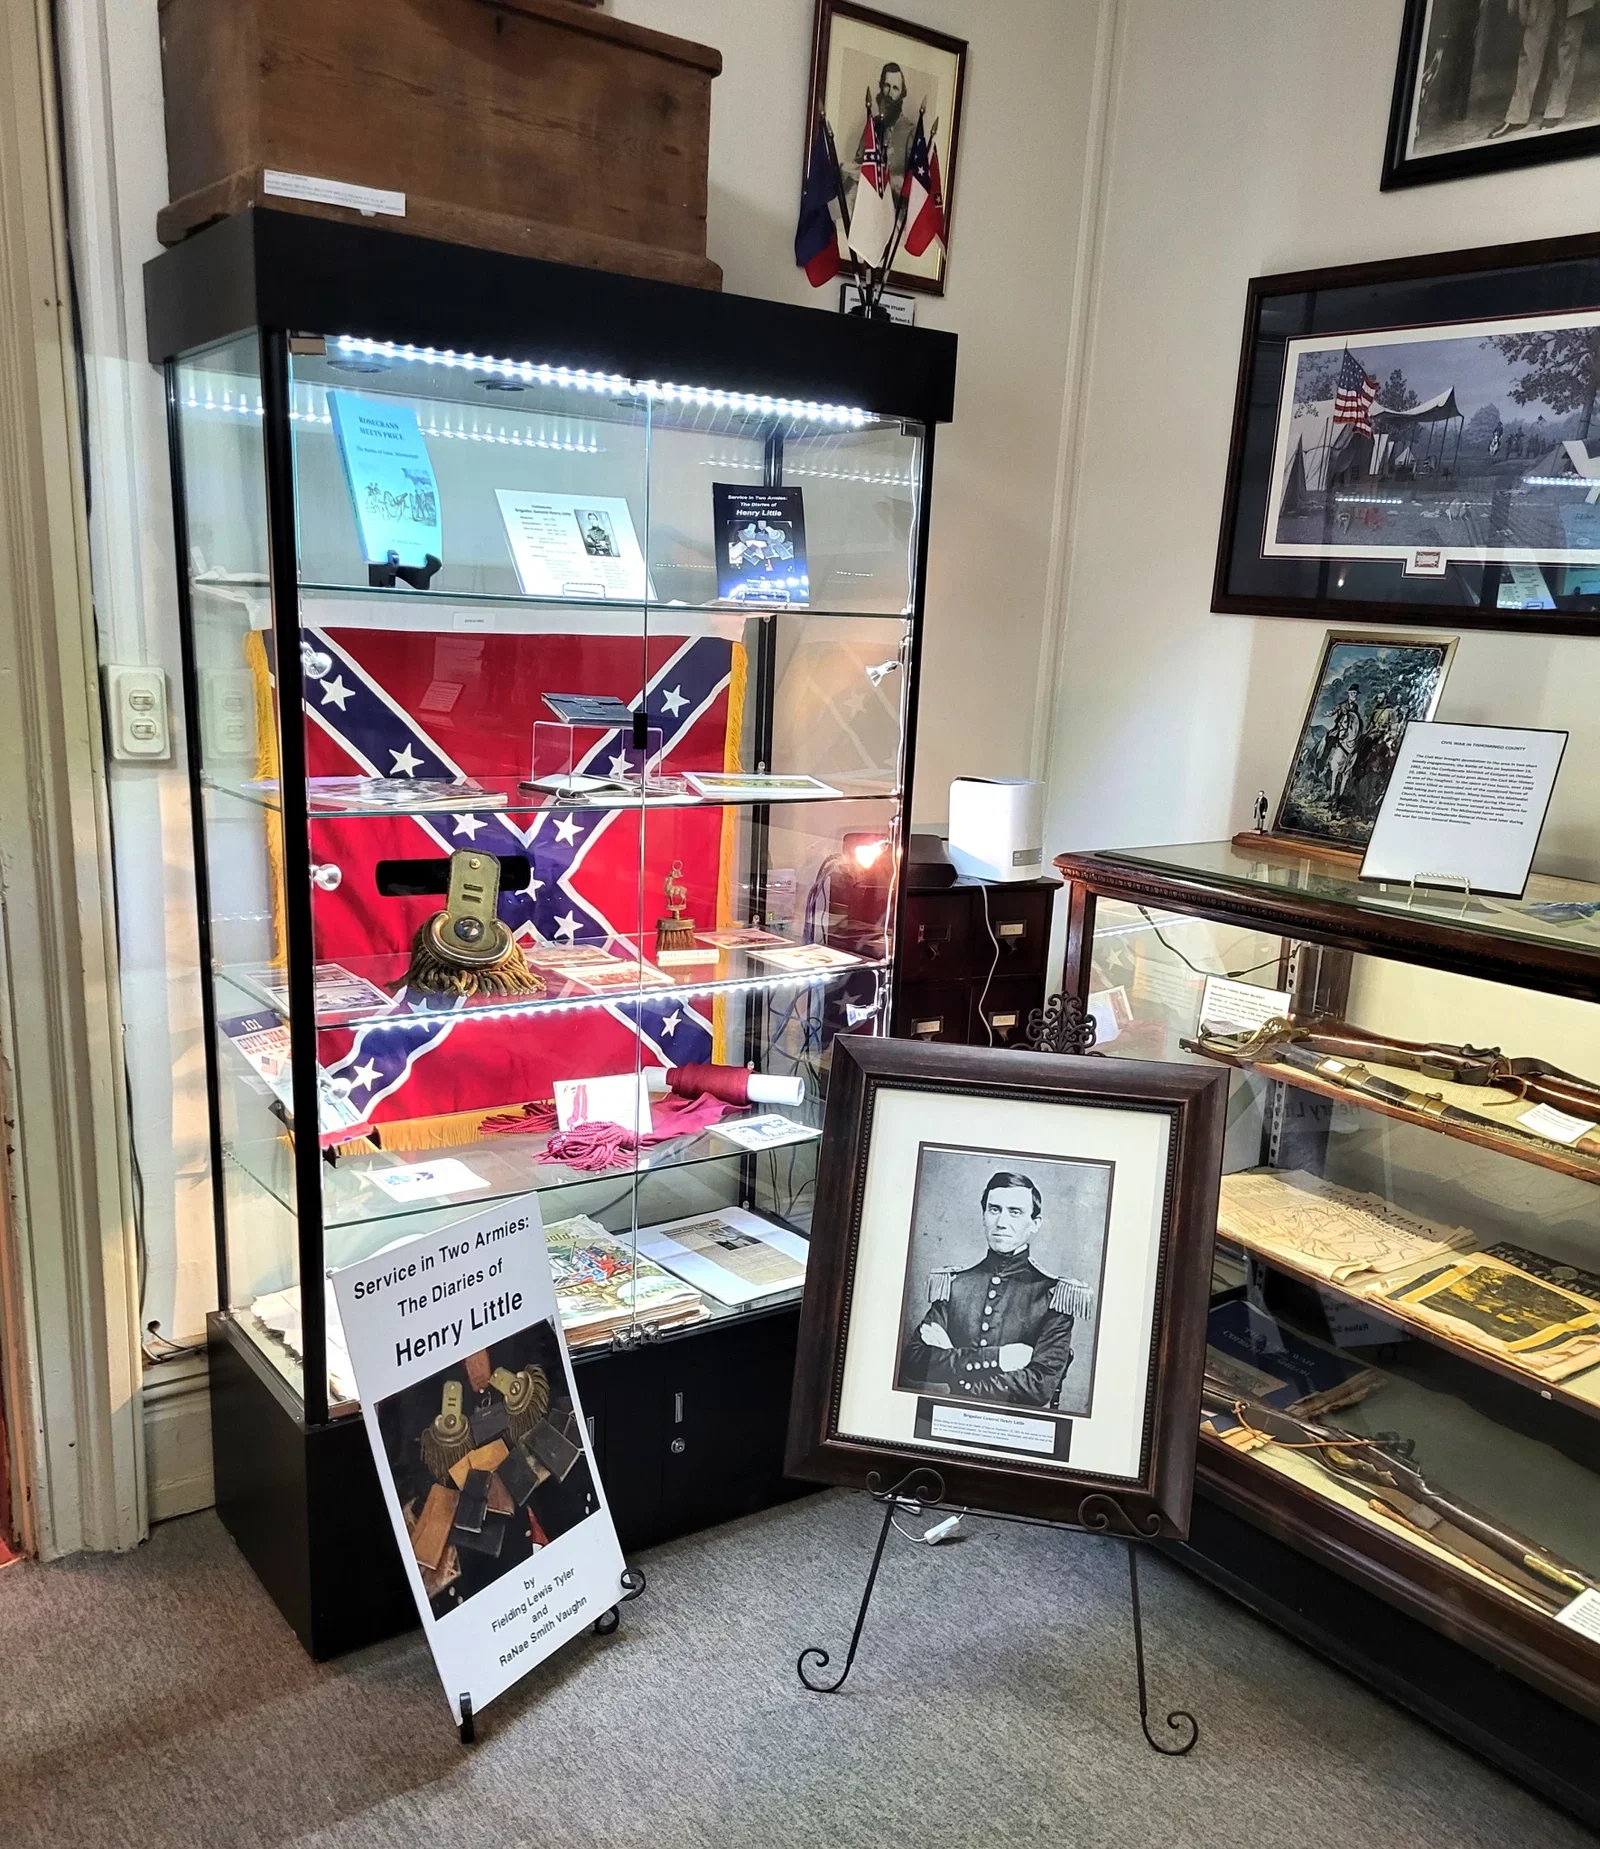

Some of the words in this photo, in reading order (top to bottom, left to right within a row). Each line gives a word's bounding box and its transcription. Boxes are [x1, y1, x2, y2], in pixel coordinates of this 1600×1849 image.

[358, 416, 399, 429] ROSECRANS
[359, 427, 382, 437] MEETS
[383, 431, 405, 440] PRICE
[241, 1018, 263, 1031] 101
[237, 1034, 268, 1050] CIVIL
[264, 1029, 291, 1043] WAR
[353, 1263, 417, 1300] Service
[420, 1255, 435, 1272] in
[438, 1241, 470, 1263] Two
[475, 1216, 529, 1250] Armies:
[397, 1295, 428, 1317] The
[431, 1270, 484, 1303] Diaries
[488, 1257, 503, 1277] of
[395, 1318, 463, 1367] Henry
[470, 1291, 523, 1331] Little
[523, 1577, 535, 1590] by
[491, 1603, 527, 1633] Fielding
[526, 1584, 553, 1607] Lewis
[553, 1568, 574, 1587] Tyler
[532, 1604, 549, 1623] and
[499, 1640, 529, 1667] RaNae
[530, 1620, 556, 1643] Smith
[555, 1596, 587, 1623] Vaughn
